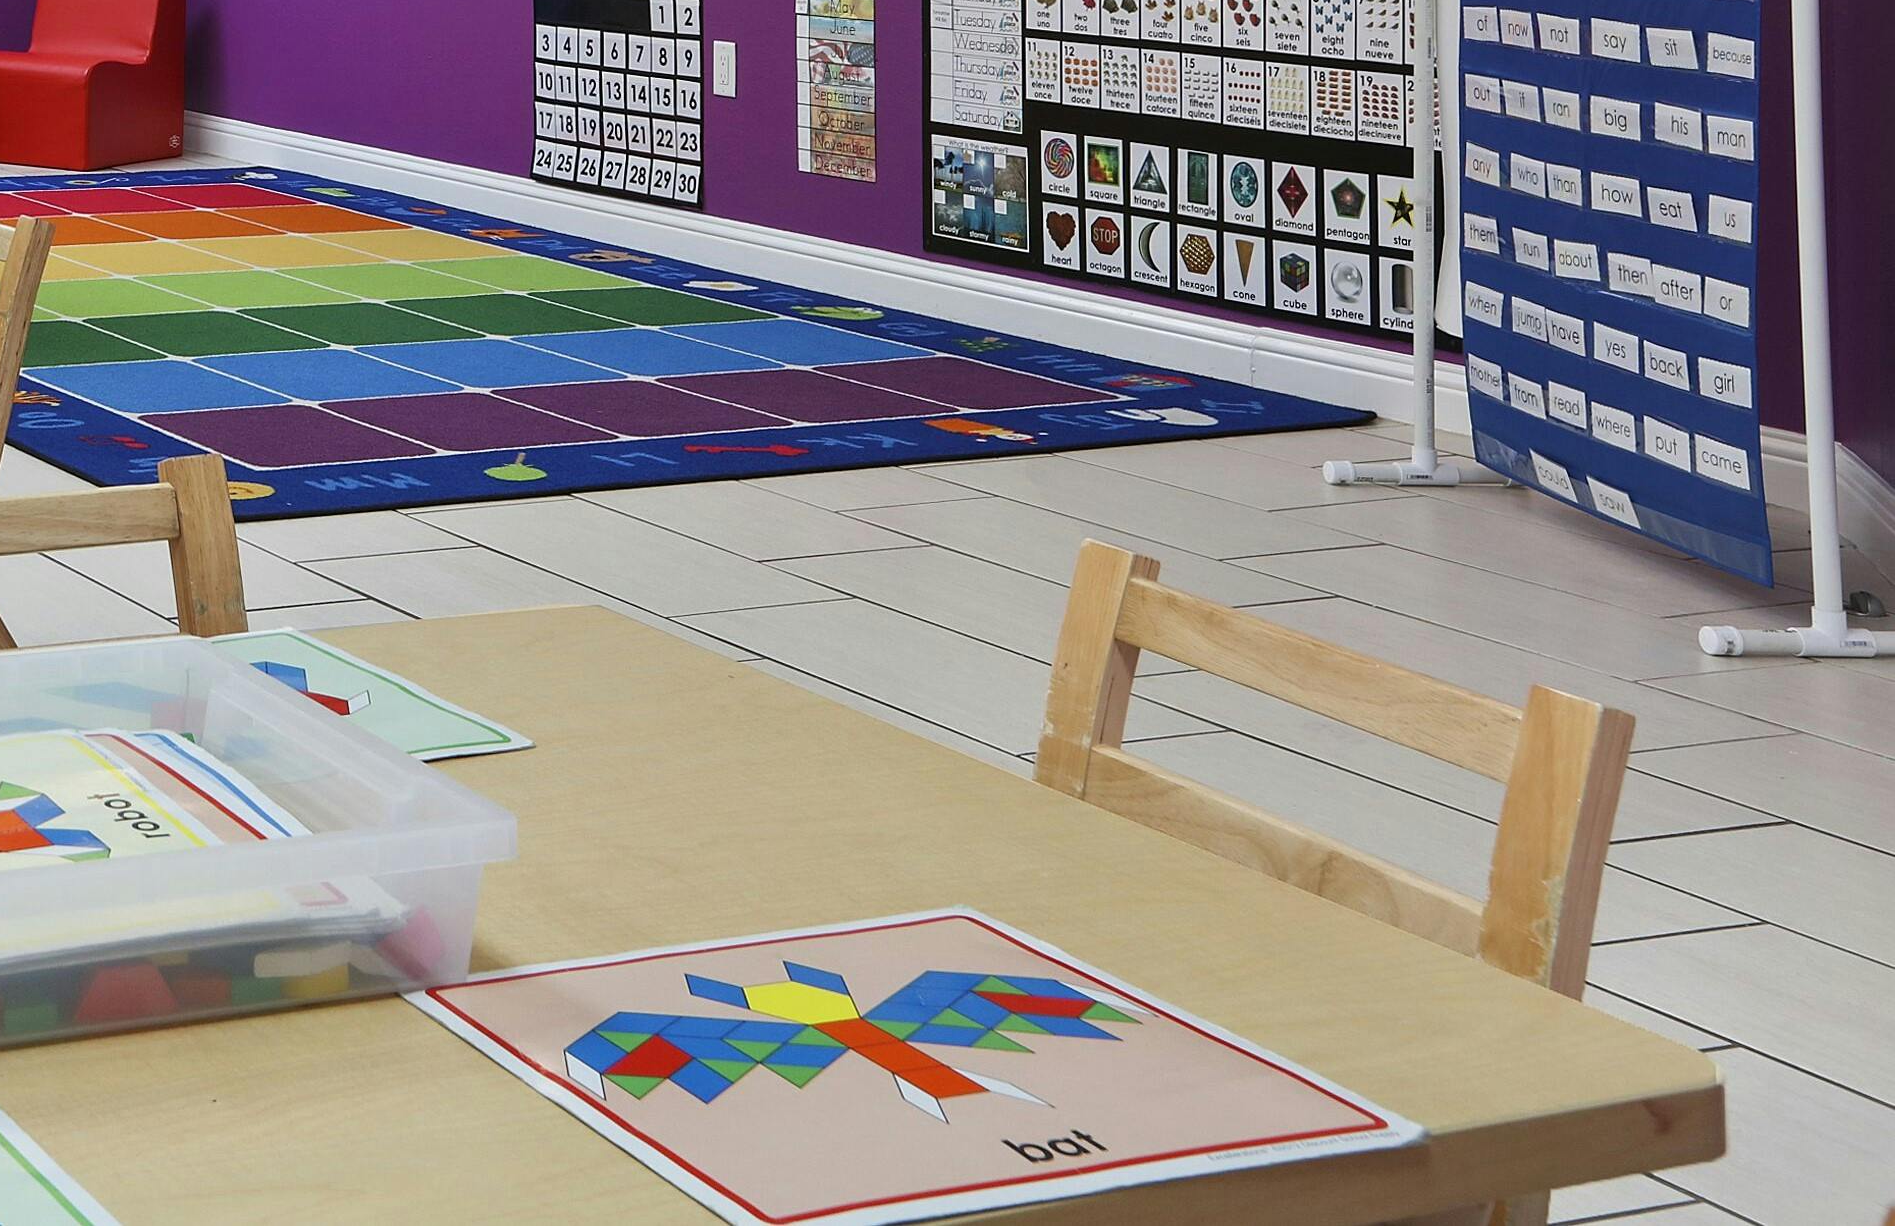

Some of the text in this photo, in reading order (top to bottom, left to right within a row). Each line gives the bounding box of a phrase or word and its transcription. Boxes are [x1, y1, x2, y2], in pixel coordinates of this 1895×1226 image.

[658, 5, 693, 26] 1 2
[954, 8, 996, 34] Tuesday
[542, 34, 693, 68] 3 4 5 6 7 8 9
[1275, 31, 1300, 42] seven
[1321, 34, 1344, 46] eight
[1321, 45, 1344, 56] ocho
[1369, 38, 1389, 48] nine
[1476, 15, 1752, 66] of now not say sit because
[1365, 50, 1394, 61] nueve
[539, 72, 697, 110] 10 11 12 13 14 15 16
[815, 84, 872, 107] September
[539, 111, 698, 153] 17 18 19 20 21 22 23
[954, 104, 1002, 131] Saturday
[1316, 115, 1352, 127] eighteen
[1361, 119, 1399, 131] nineteen
[1473, 86, 1746, 149] out if ran big his man
[536, 149, 697, 194] 24 25 26 27 28 29 30
[1472, 157, 1736, 228] any who than how eat us
[1048, 183, 1412, 247] circle square triangle rectangle oval diamond pentagon star
[1092, 227, 1118, 244] STOP
[1469, 224, 1733, 311] them run about then after or
[1051, 254, 1414, 330] heart octagon crescent hexagon cone cube sphere cylind
[1468, 294, 1735, 395] when jump have yes back girl
[1514, 383, 1538, 407] from
[1554, 395, 1580, 417] read
[1595, 414, 1631, 438] where
[1655, 435, 1678, 454] put
[1702, 450, 1743, 474] came
[1599, 491, 1626, 514] saw
[86, 792, 171, 839] robot
[1001, 1129, 1108, 1164] bat
